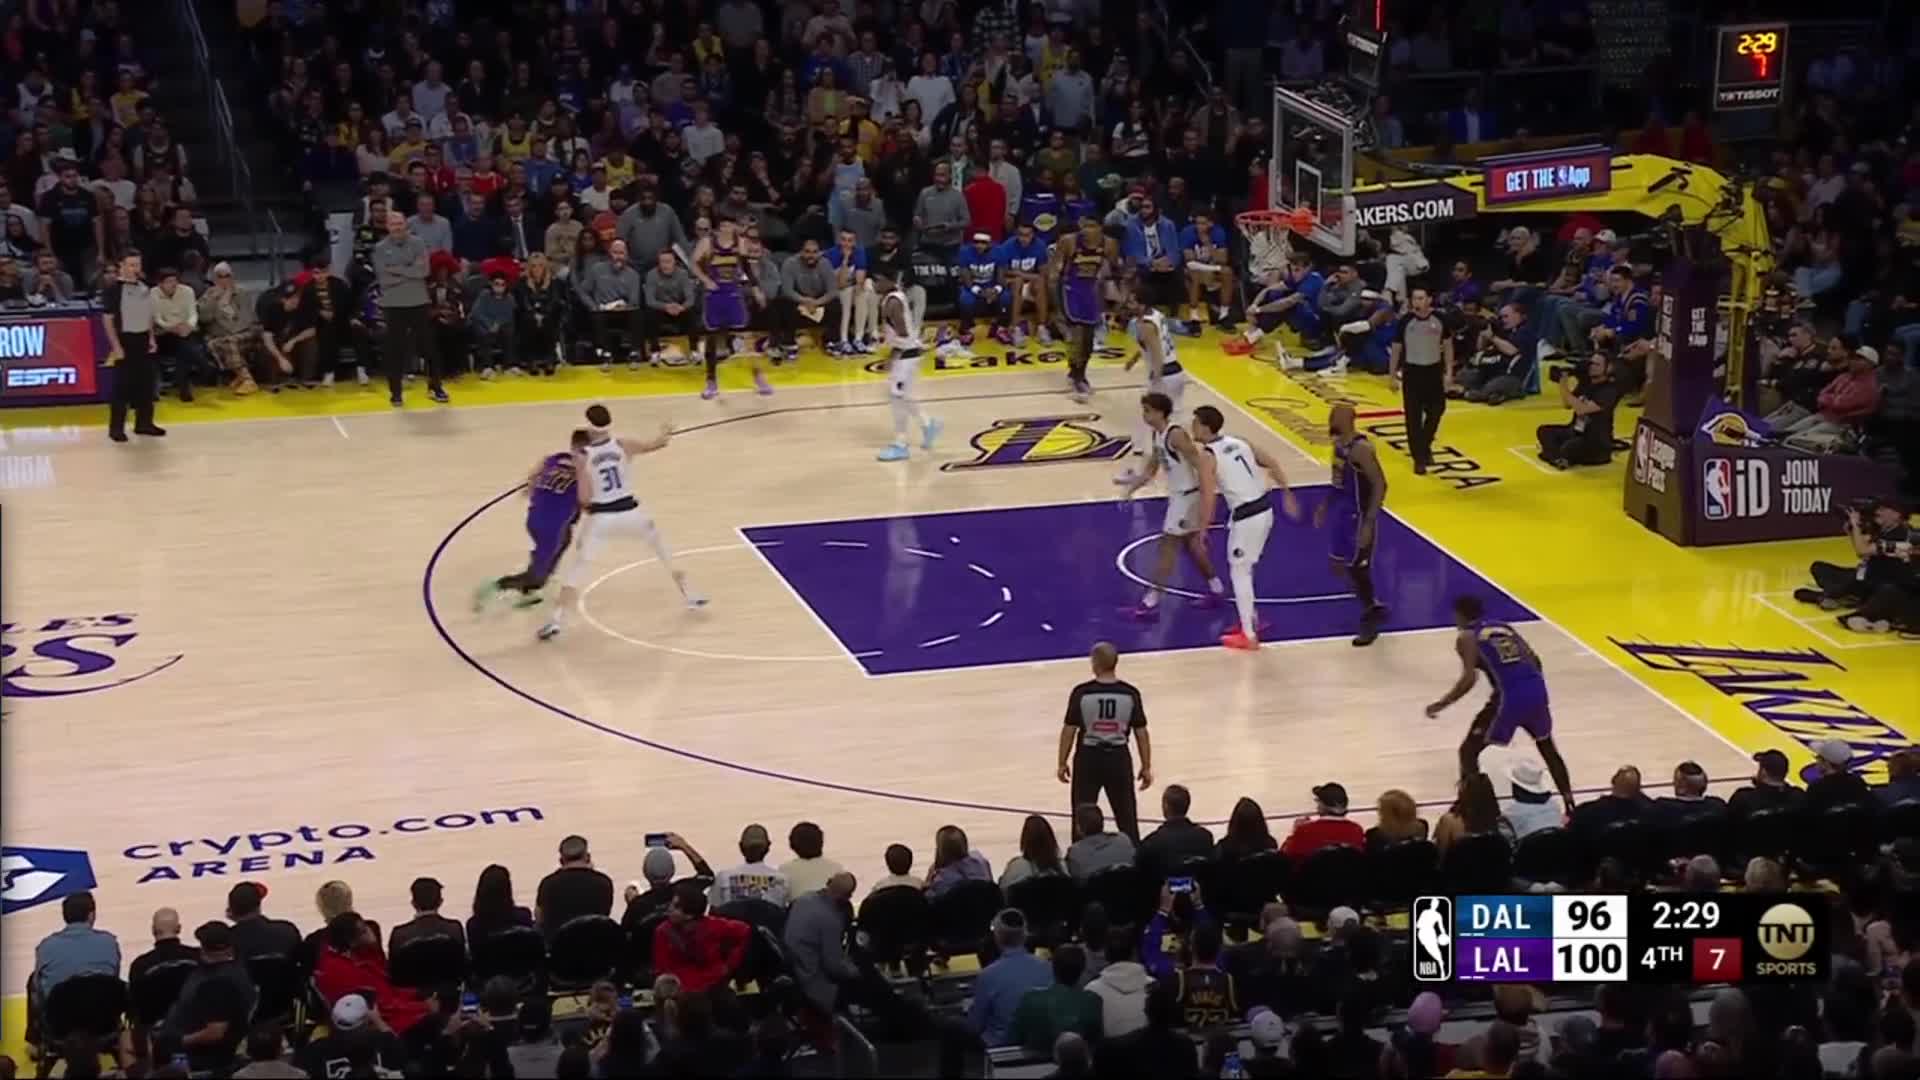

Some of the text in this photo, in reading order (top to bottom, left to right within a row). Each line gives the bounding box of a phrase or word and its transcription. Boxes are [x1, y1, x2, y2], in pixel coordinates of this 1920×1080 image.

[1737, 31, 1777, 54] 2:29
[1753, 53, 1767, 77] 7
[1506, 165, 1591, 193] GET THE App
[7, 367, 77, 387] ESPN
[599, 465, 623, 492] 31
[1781, 459, 1819, 486] JOIN
[1782, 487, 1832, 514] TODAY
[1098, 699, 1117, 719] 10
[122, 805, 545, 861] crypto.com
[136, 845, 376, 885] ARENA
